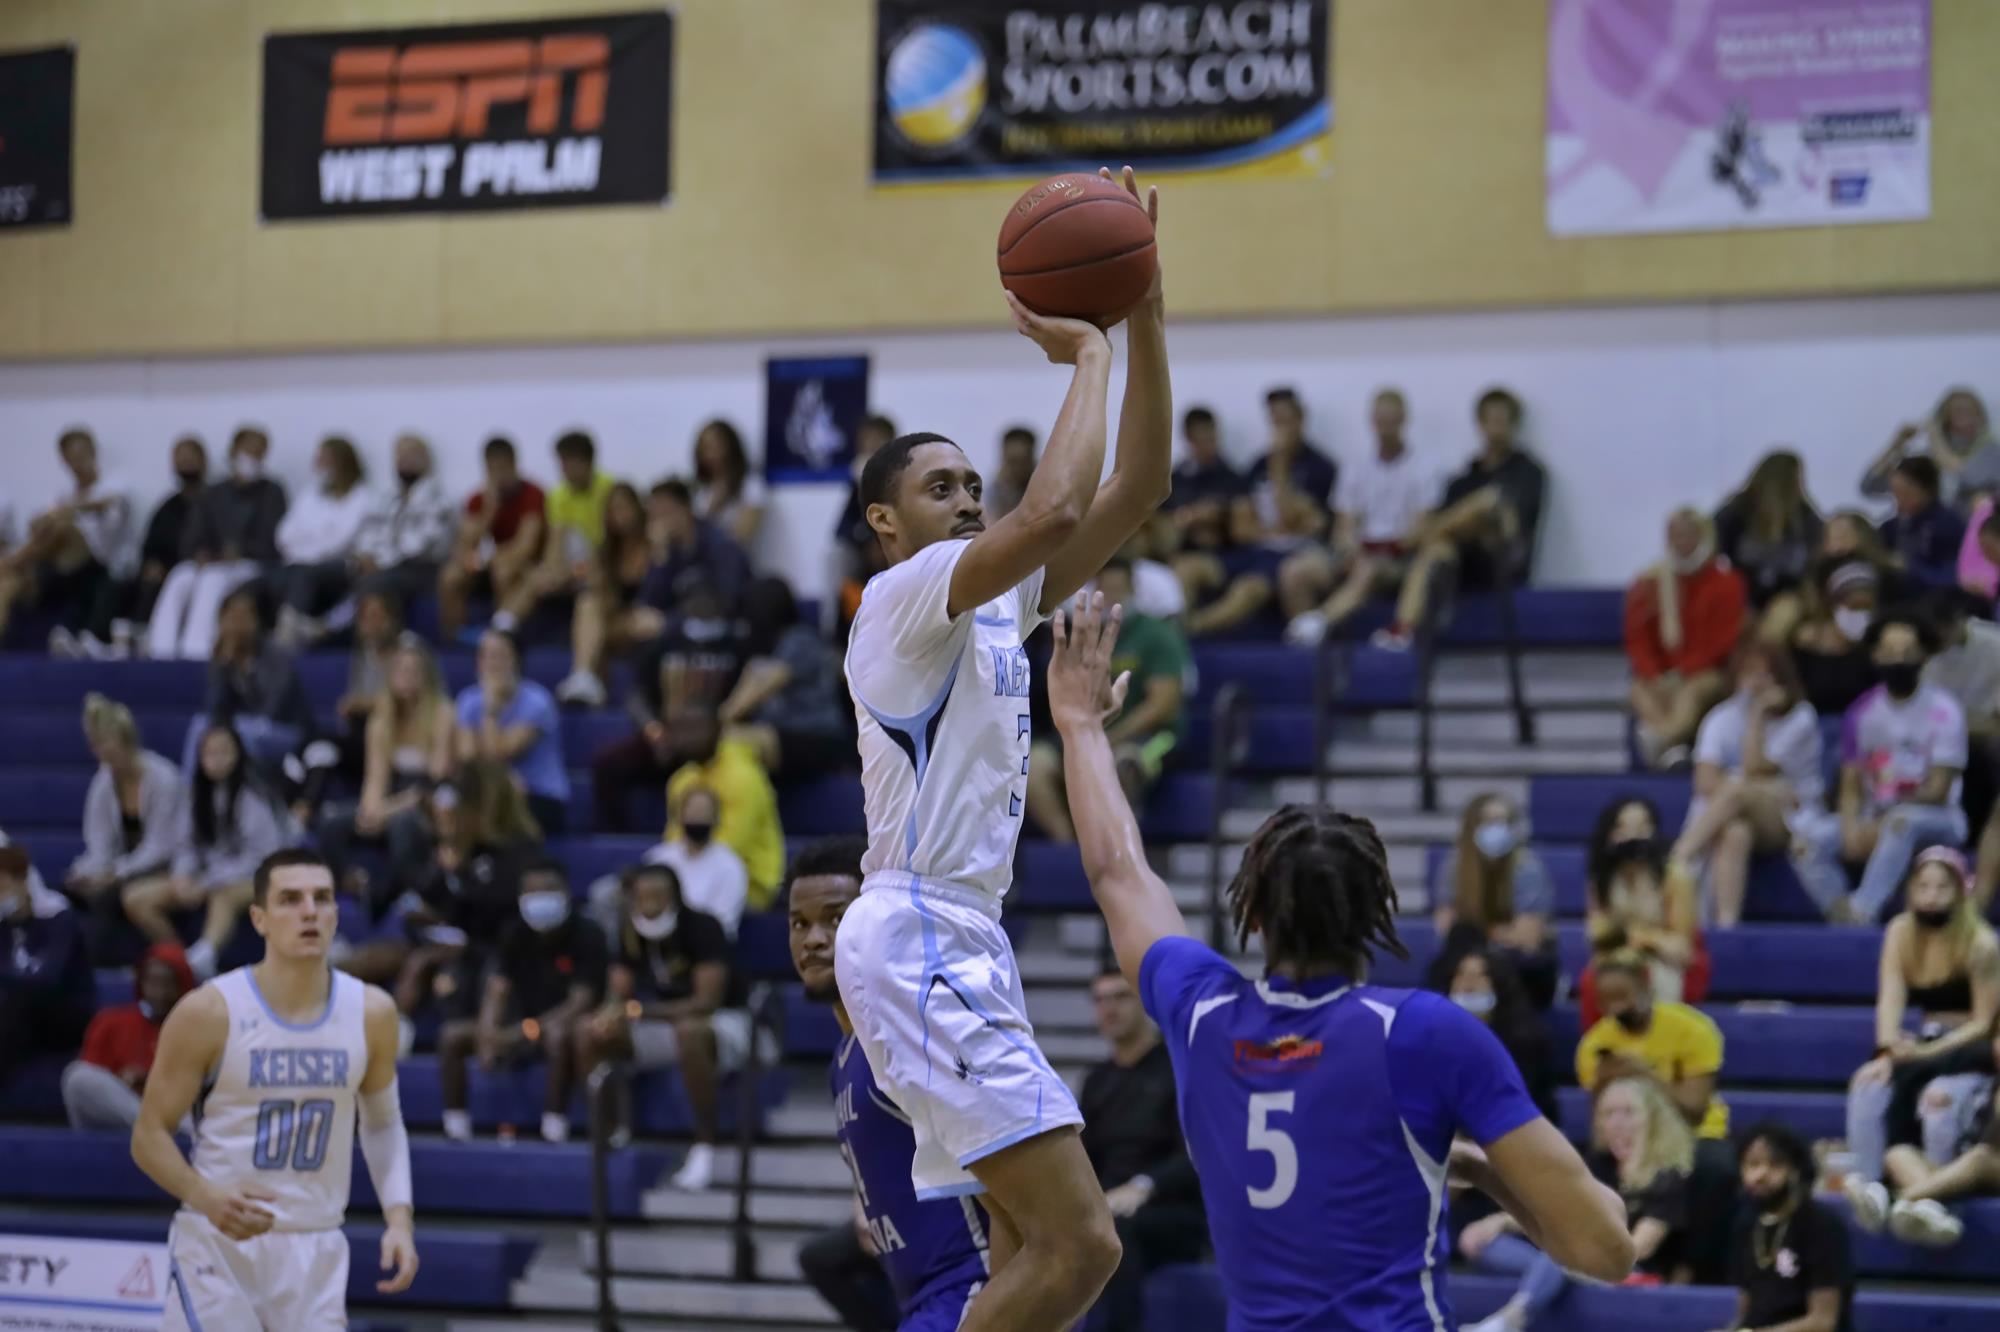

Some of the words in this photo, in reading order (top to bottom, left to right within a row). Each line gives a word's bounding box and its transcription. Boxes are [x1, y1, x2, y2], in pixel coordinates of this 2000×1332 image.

[322, 33, 611, 146] ESPN
[318, 144, 457, 204] WEST
[460, 136, 602, 197] PALM
[248, 1048, 349, 1088] KEISER
[253, 1098, 335, 1172] 00
[1246, 1090, 1298, 1209] 5
